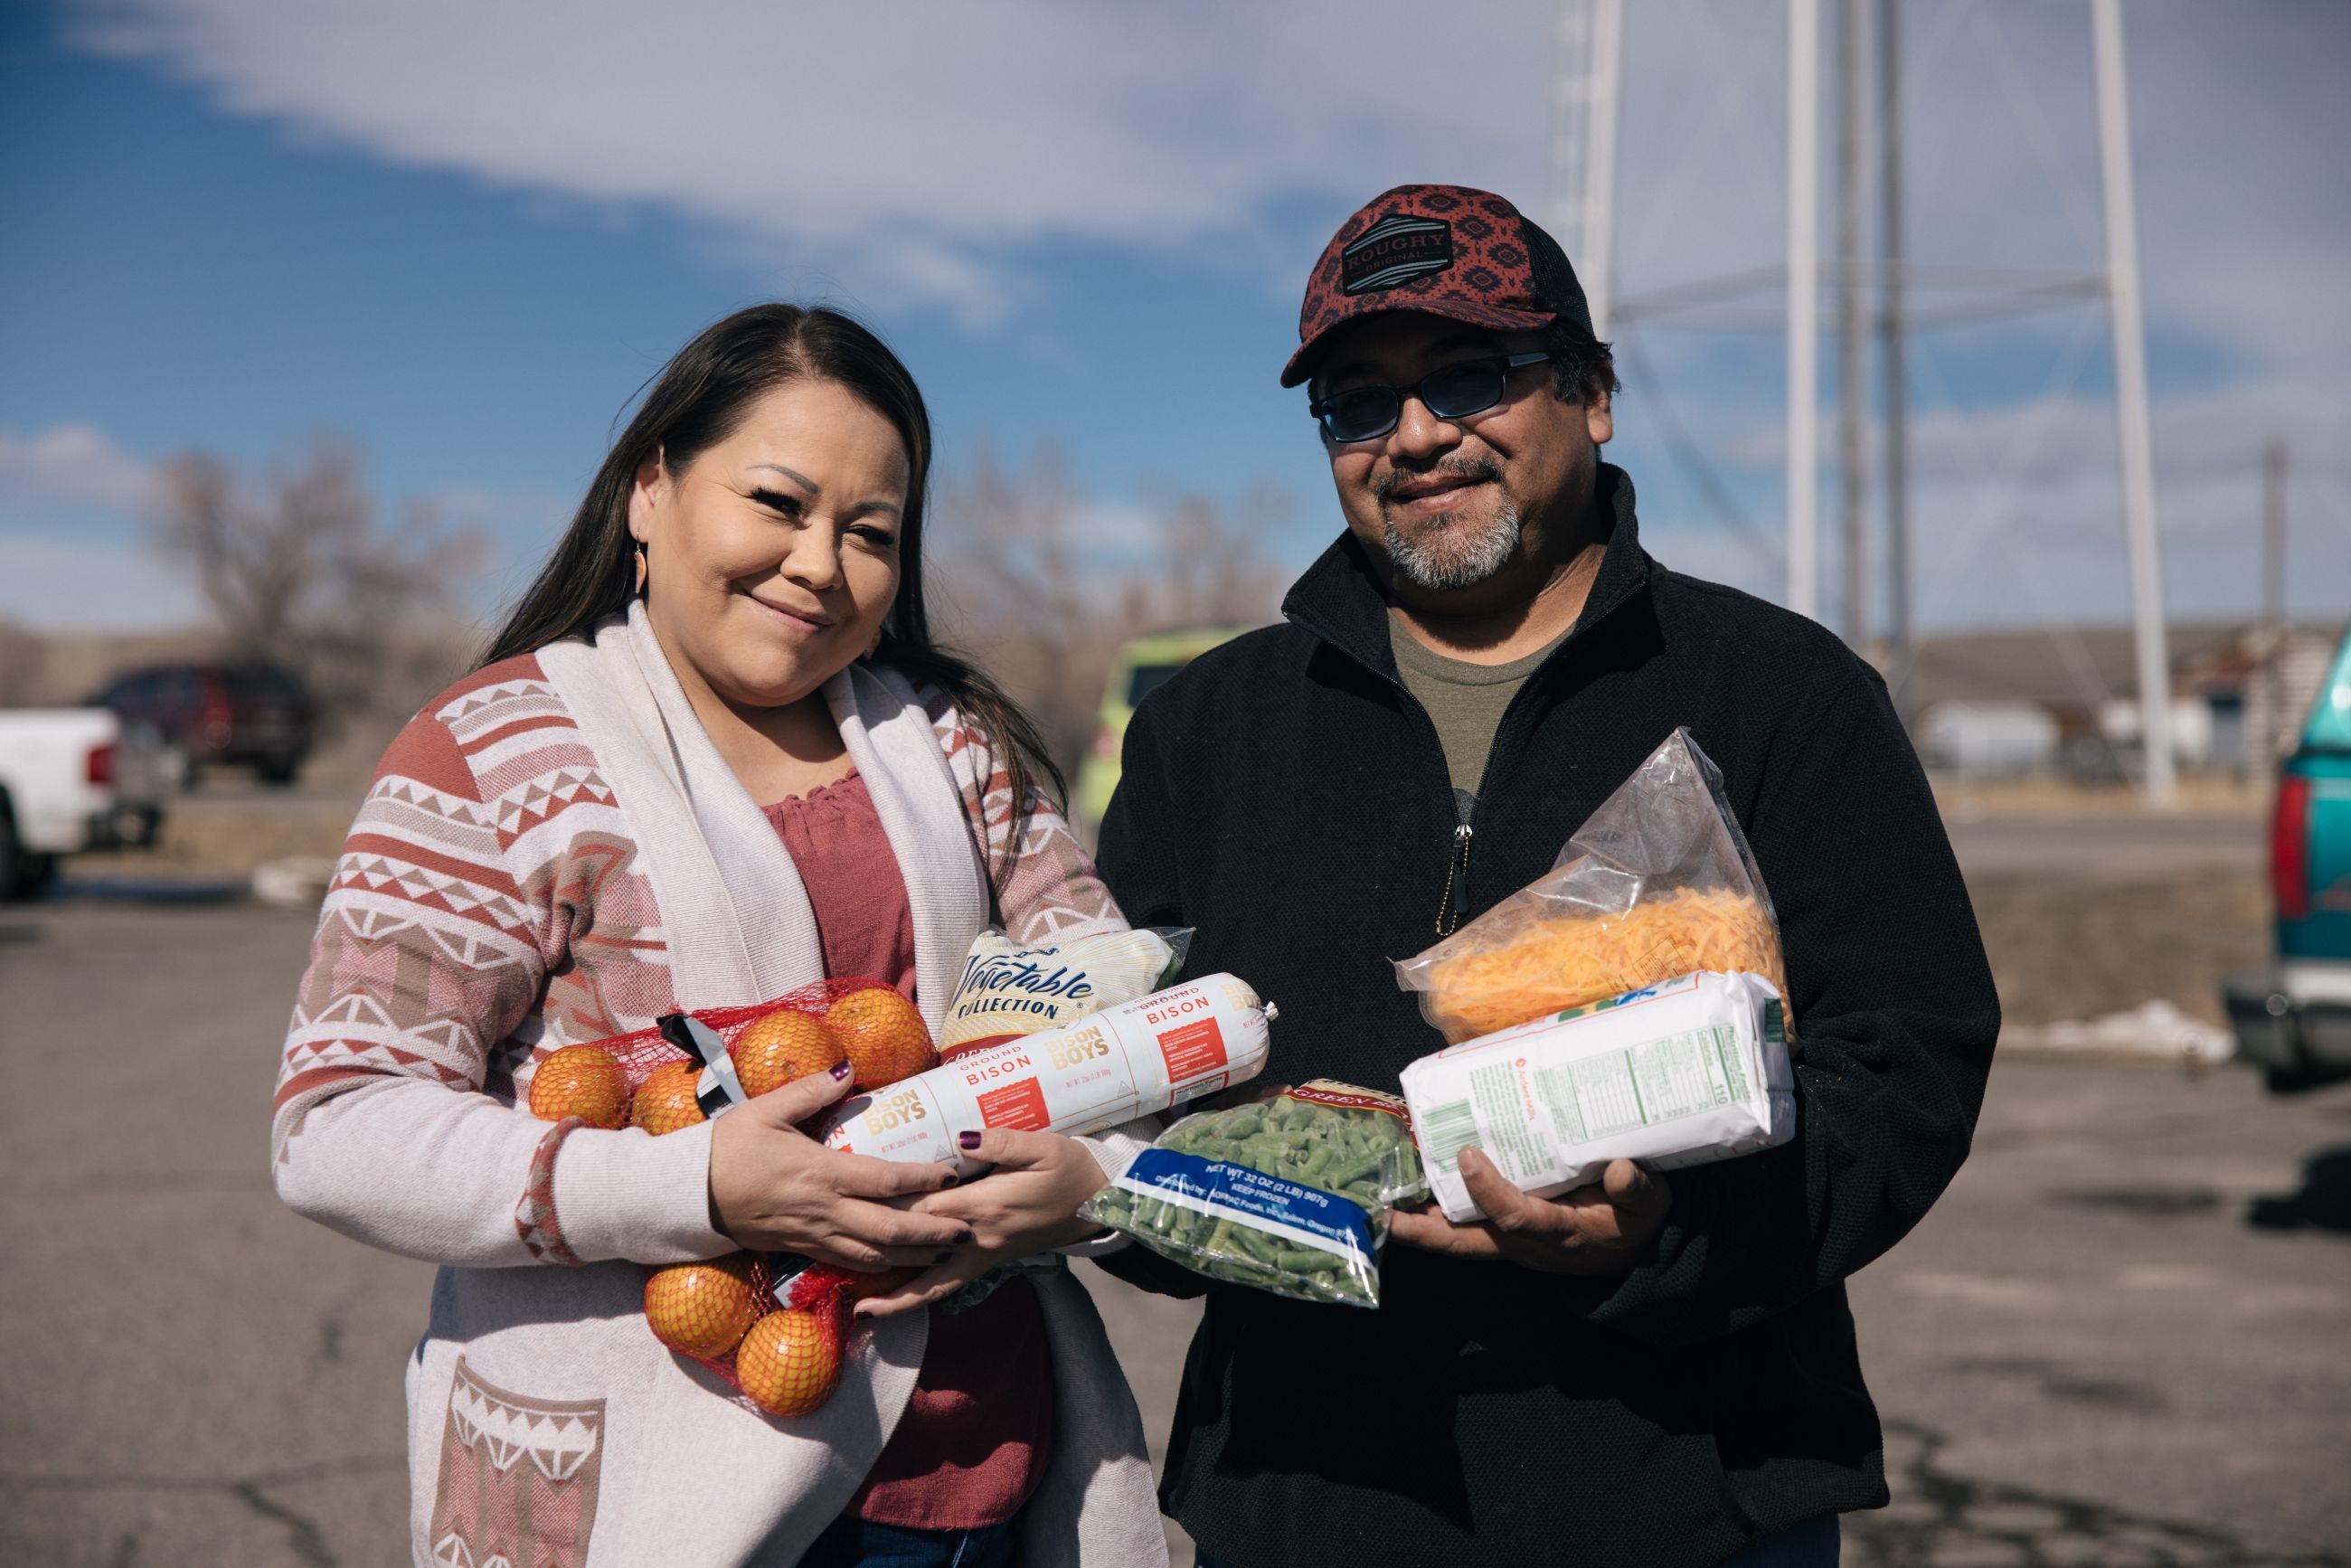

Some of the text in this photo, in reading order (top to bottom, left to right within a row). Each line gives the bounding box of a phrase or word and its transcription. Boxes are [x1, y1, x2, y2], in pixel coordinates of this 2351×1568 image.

[1348, 235, 1445, 270] ROUGHY
[1365, 250, 1424, 272] ORIGINAL
[950, 954, 1094, 1011] Vegetable
[958, 997, 1060, 1020] COLLECTION
[1138, 987, 1201, 1010] GROUND
[1146, 996, 1211, 1025] BISON
[1044, 1025, 1102, 1053] BISON
[1729, 1025, 1742, 1073] Nutrition
[958, 1046, 1022, 1071] GROUND
[1050, 1038, 1110, 1072] BOYS
[1699, 1030, 1728, 1104] Calories 110
[966, 1055, 1032, 1086] BISON
[862, 1089, 919, 1119] BISON
[1293, 1089, 1371, 1104] GREEN
[865, 1100, 927, 1137] BOYS
[1205, 1164, 1329, 1208] NET WT 32 OZ (2 LB) 907g
[1232, 1183, 1290, 1205] KEEP FROZEN
[1307, 1219, 1336, 1237] Oregon
